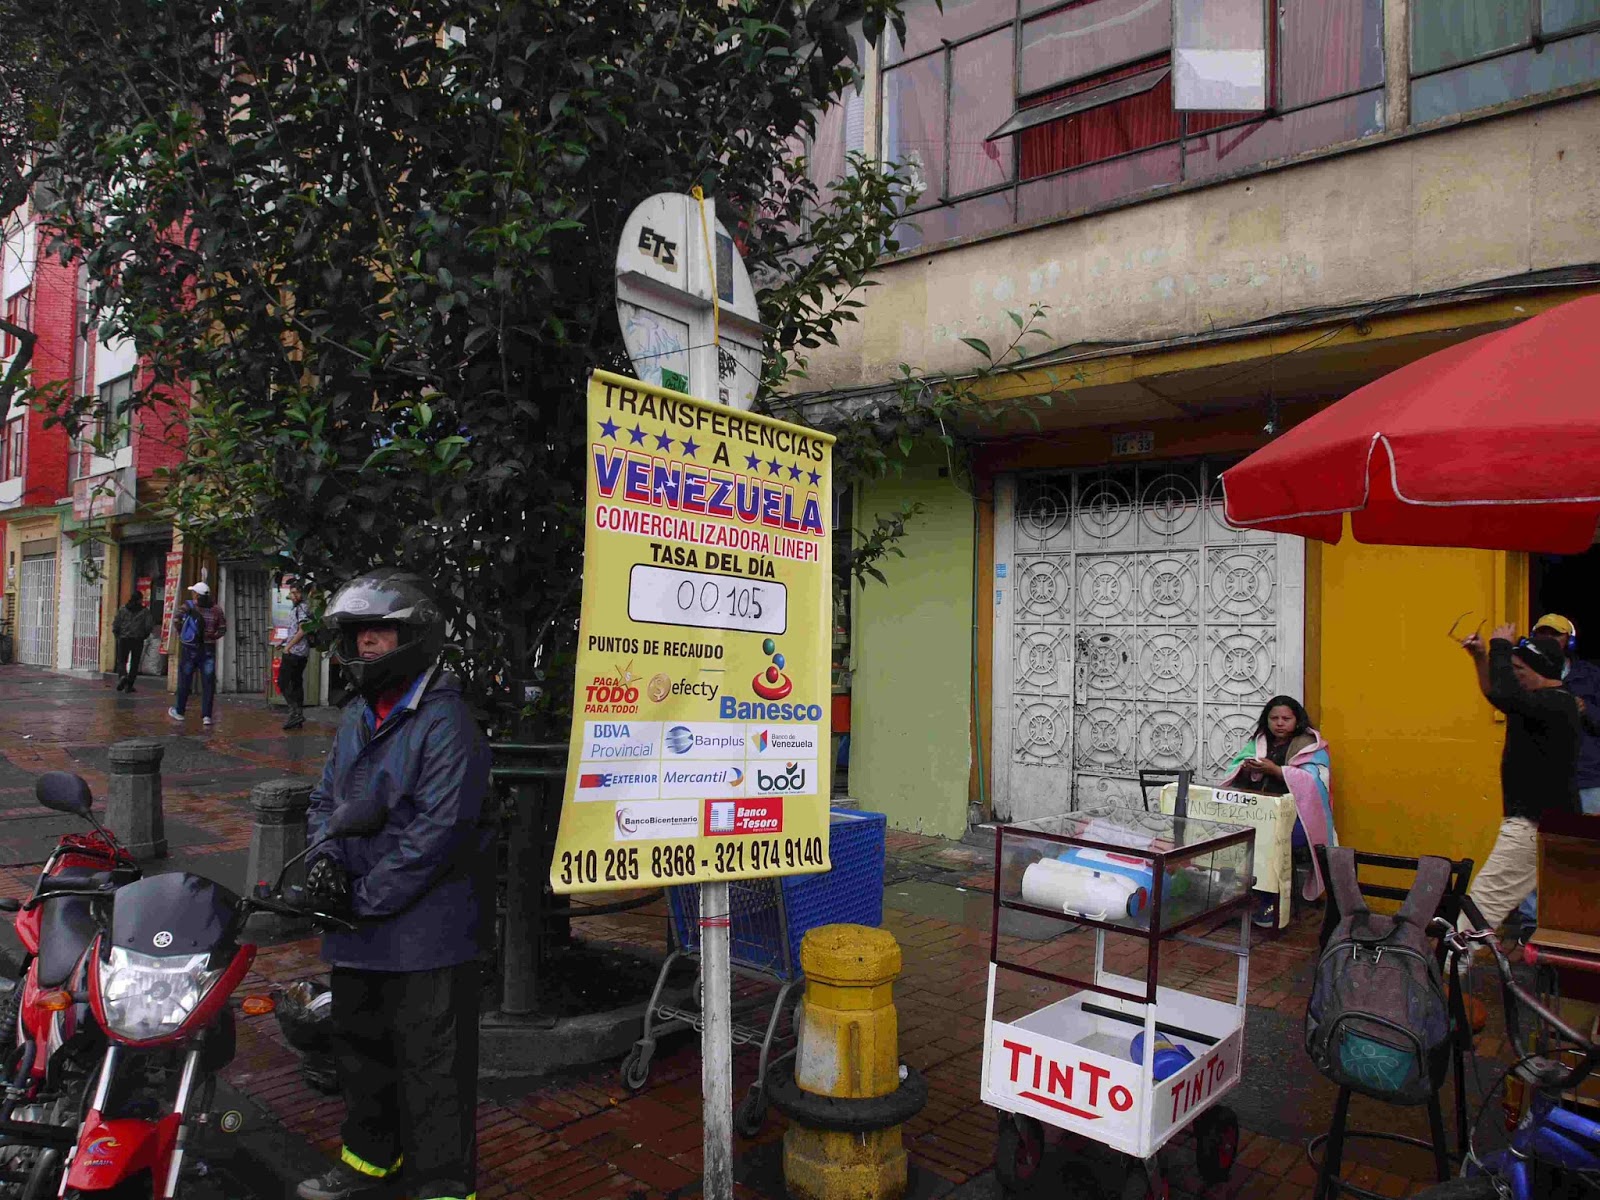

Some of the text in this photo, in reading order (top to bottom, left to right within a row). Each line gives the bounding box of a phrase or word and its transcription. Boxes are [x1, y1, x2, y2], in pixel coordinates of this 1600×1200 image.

[638, 226, 677, 269] ETS
[602, 381, 824, 461] TRANSFERENCIAS
[712, 442, 730, 467] A
[592, 444, 825, 536] VENEZUELA
[596, 505, 819, 561] COMERCIALIZADORA LINEPI
[650, 543, 775, 578] TASA DEL DÍA
[588, 636, 724, 659] PUNTOS DE RECAUDO
[593, 677, 619, 687] PAGA
[672, 679, 719, 700] efecty
[585, 686, 639, 704] TODO
[584, 704, 639, 714] PARA TODO!
[720, 696, 822, 721] Banesco
[594, 724, 630, 738] BBVA
[695, 735, 745, 748] Banplus
[771, 739, 813, 748] Venezuela
[591, 743, 653, 758] Provincial
[612, 774, 658, 785] EXTERIOR
[664, 771, 727, 783] Mercantil
[624, 815, 698, 826] BancoBicentenario
[737, 807, 767, 818] Banco
[742, 818, 778, 829] Tesoro
[560, 837, 823, 885] 310 285 8368 - 321 974 9140
